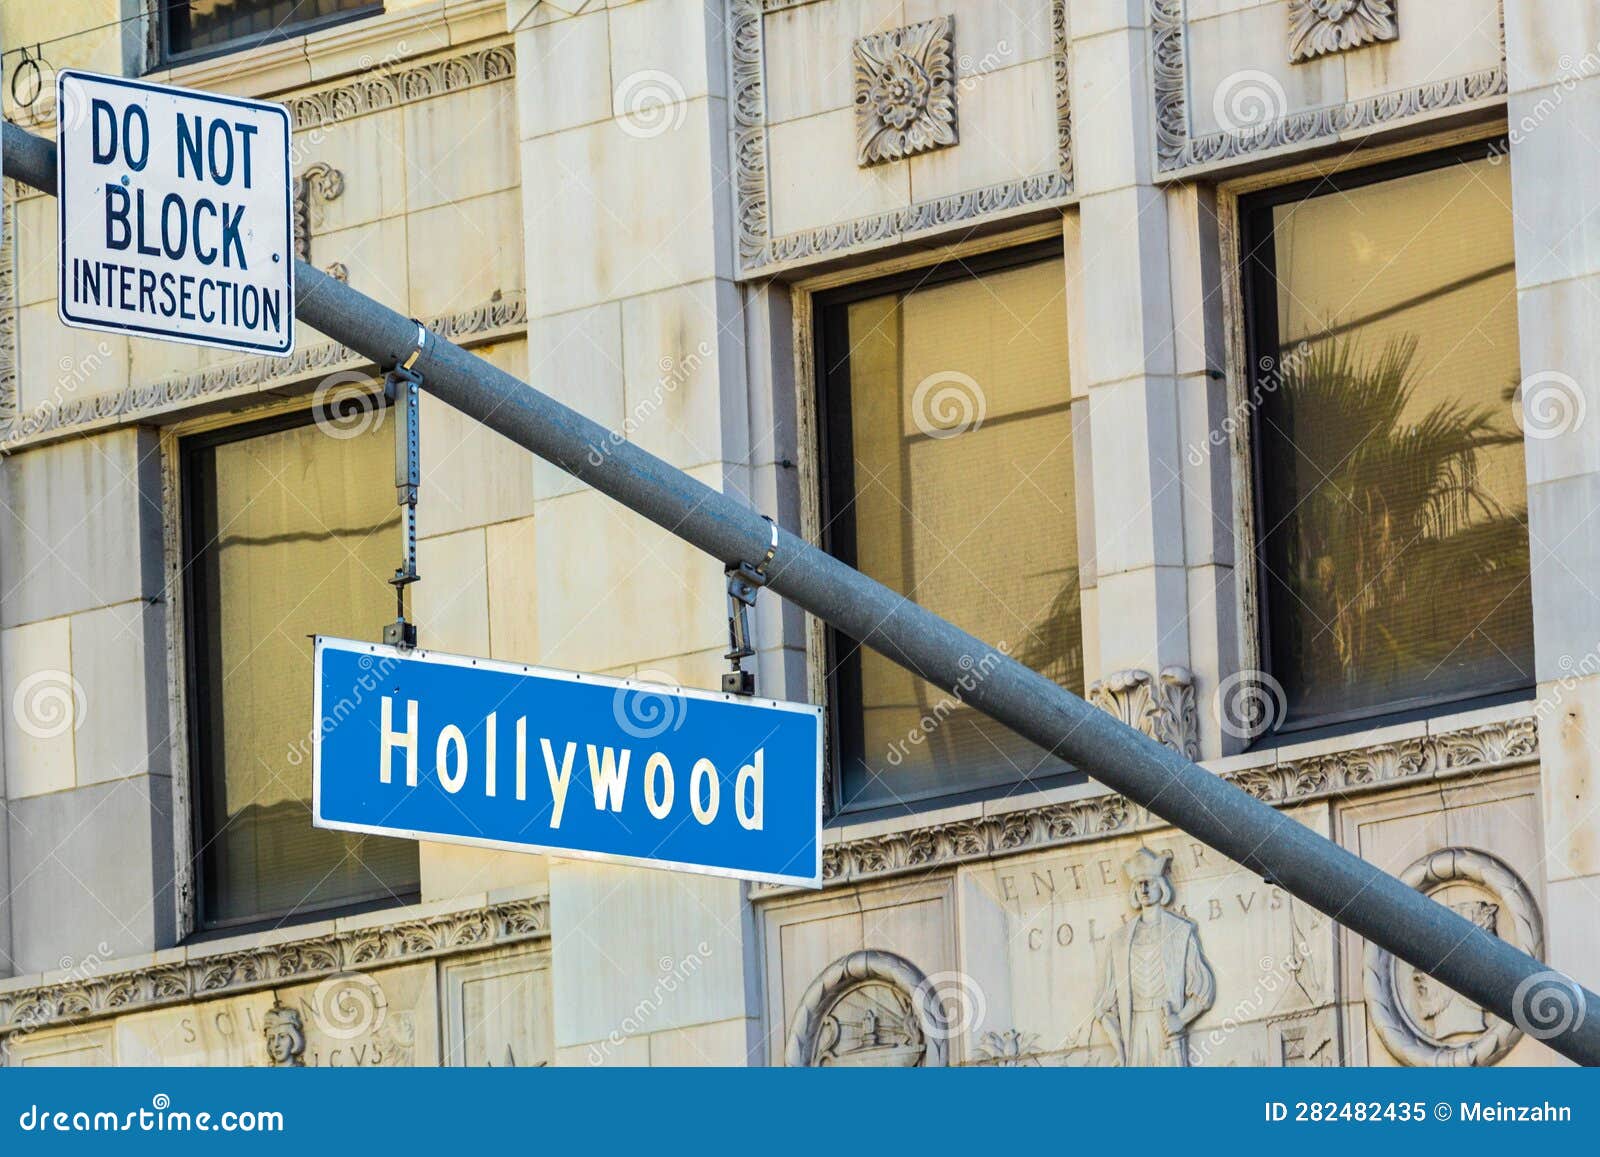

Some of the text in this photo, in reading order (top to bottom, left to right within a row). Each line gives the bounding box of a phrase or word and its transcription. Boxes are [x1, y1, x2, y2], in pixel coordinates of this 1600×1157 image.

[91, 98, 258, 189] DO NOT
[105, 183, 249, 271] BLOCK
[73, 258, 280, 334] INTERSECTION
[379, 695, 764, 830] Hollywood
